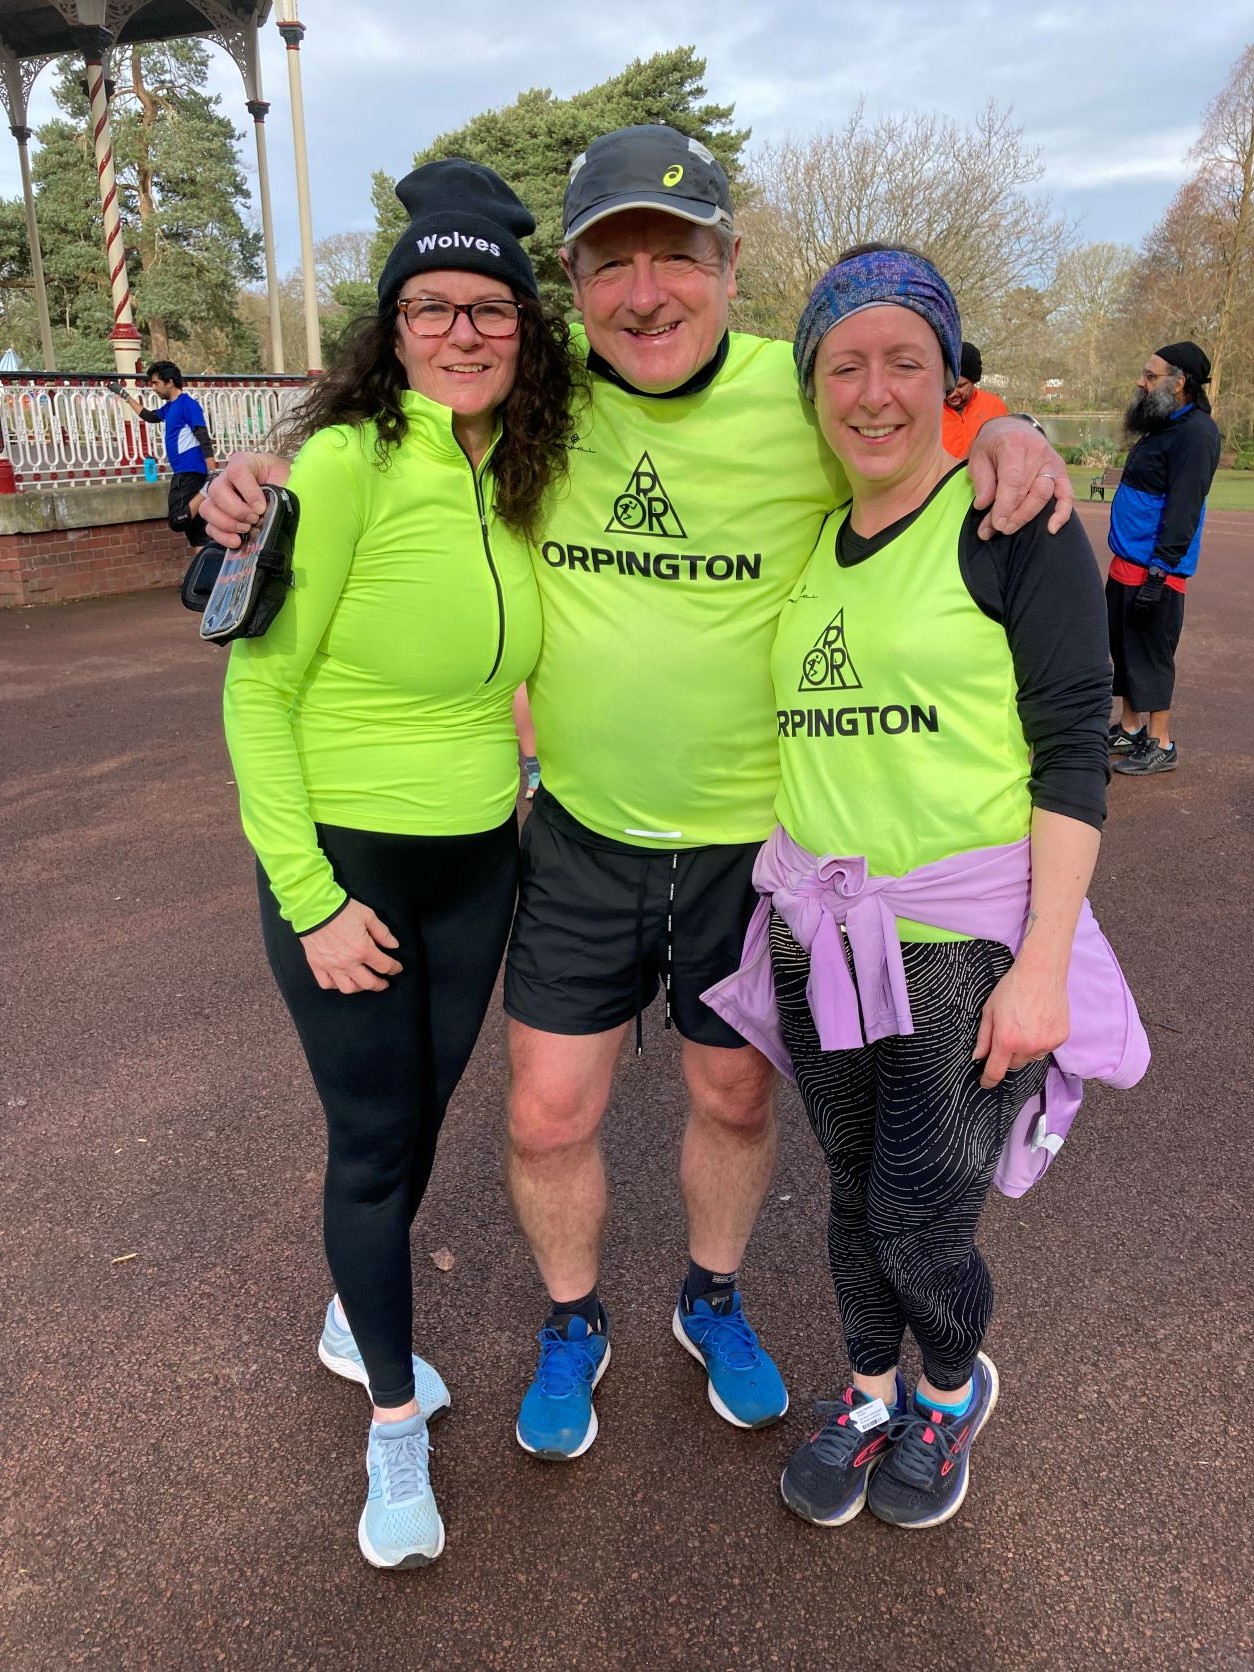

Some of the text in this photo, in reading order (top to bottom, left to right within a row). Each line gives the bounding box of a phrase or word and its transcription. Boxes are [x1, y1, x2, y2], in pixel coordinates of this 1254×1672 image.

[416, 231, 501, 257] Wolves
[541, 540, 762, 581] ORPINGTON
[776, 704, 940, 738] RPINGTON
